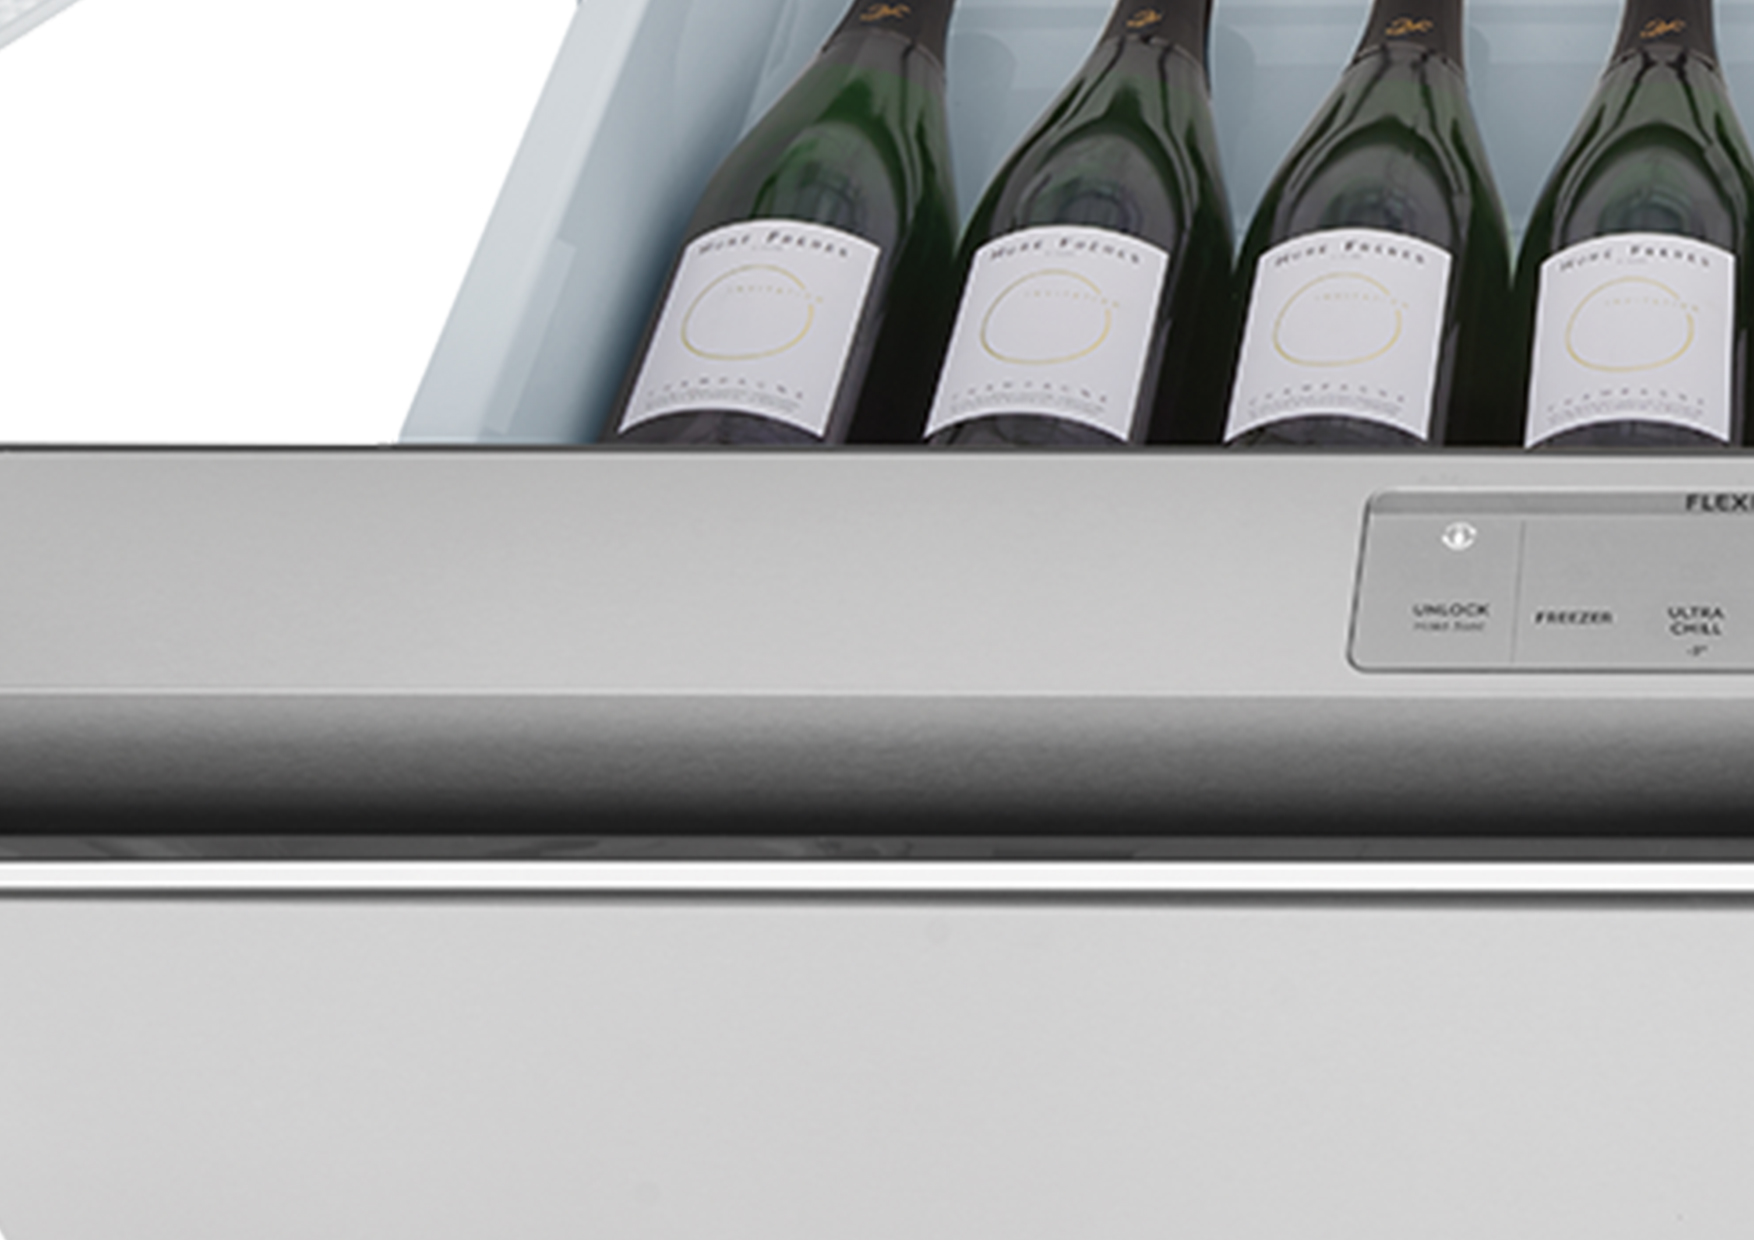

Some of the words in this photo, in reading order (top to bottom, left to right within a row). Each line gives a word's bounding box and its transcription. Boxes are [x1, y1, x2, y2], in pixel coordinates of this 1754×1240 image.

[1412, 602, 1490, 618] UNLOCK
[1534, 610, 1614, 625] FREEZER
[1666, 606, 1725, 620] ULTRA
[1669, 621, 1722, 637] CHILL
